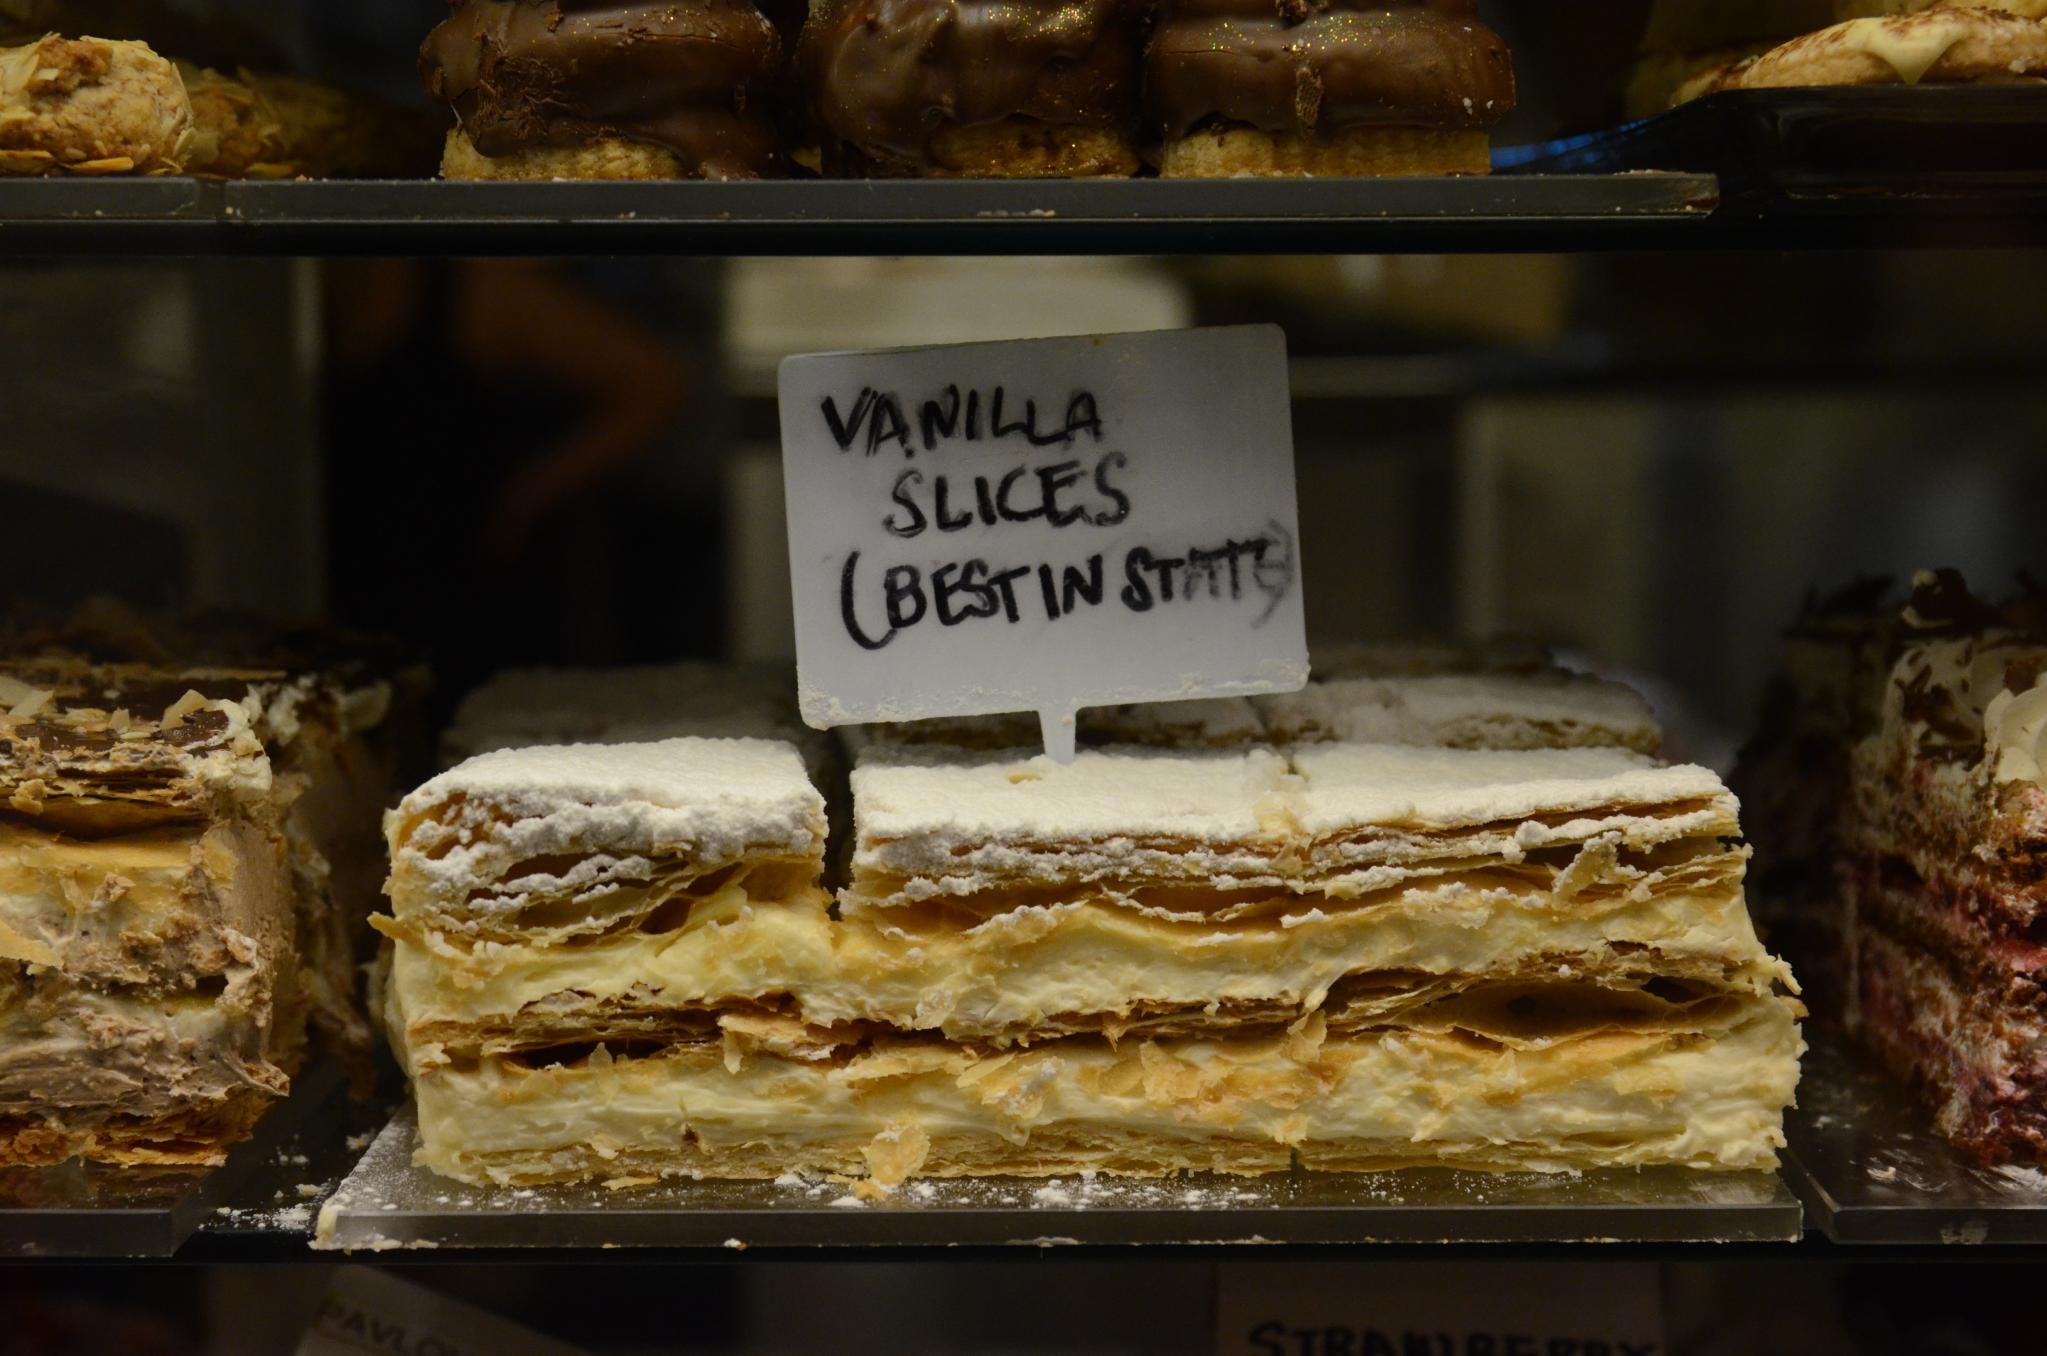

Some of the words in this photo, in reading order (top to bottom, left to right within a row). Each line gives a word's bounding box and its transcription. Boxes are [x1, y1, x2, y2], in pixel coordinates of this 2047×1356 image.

[820, 383, 1102, 458] VANILLA
[882, 451, 1131, 538] SLICES
[841, 551, 1030, 650] (BEST
[1038, 554, 1103, 621] IN
